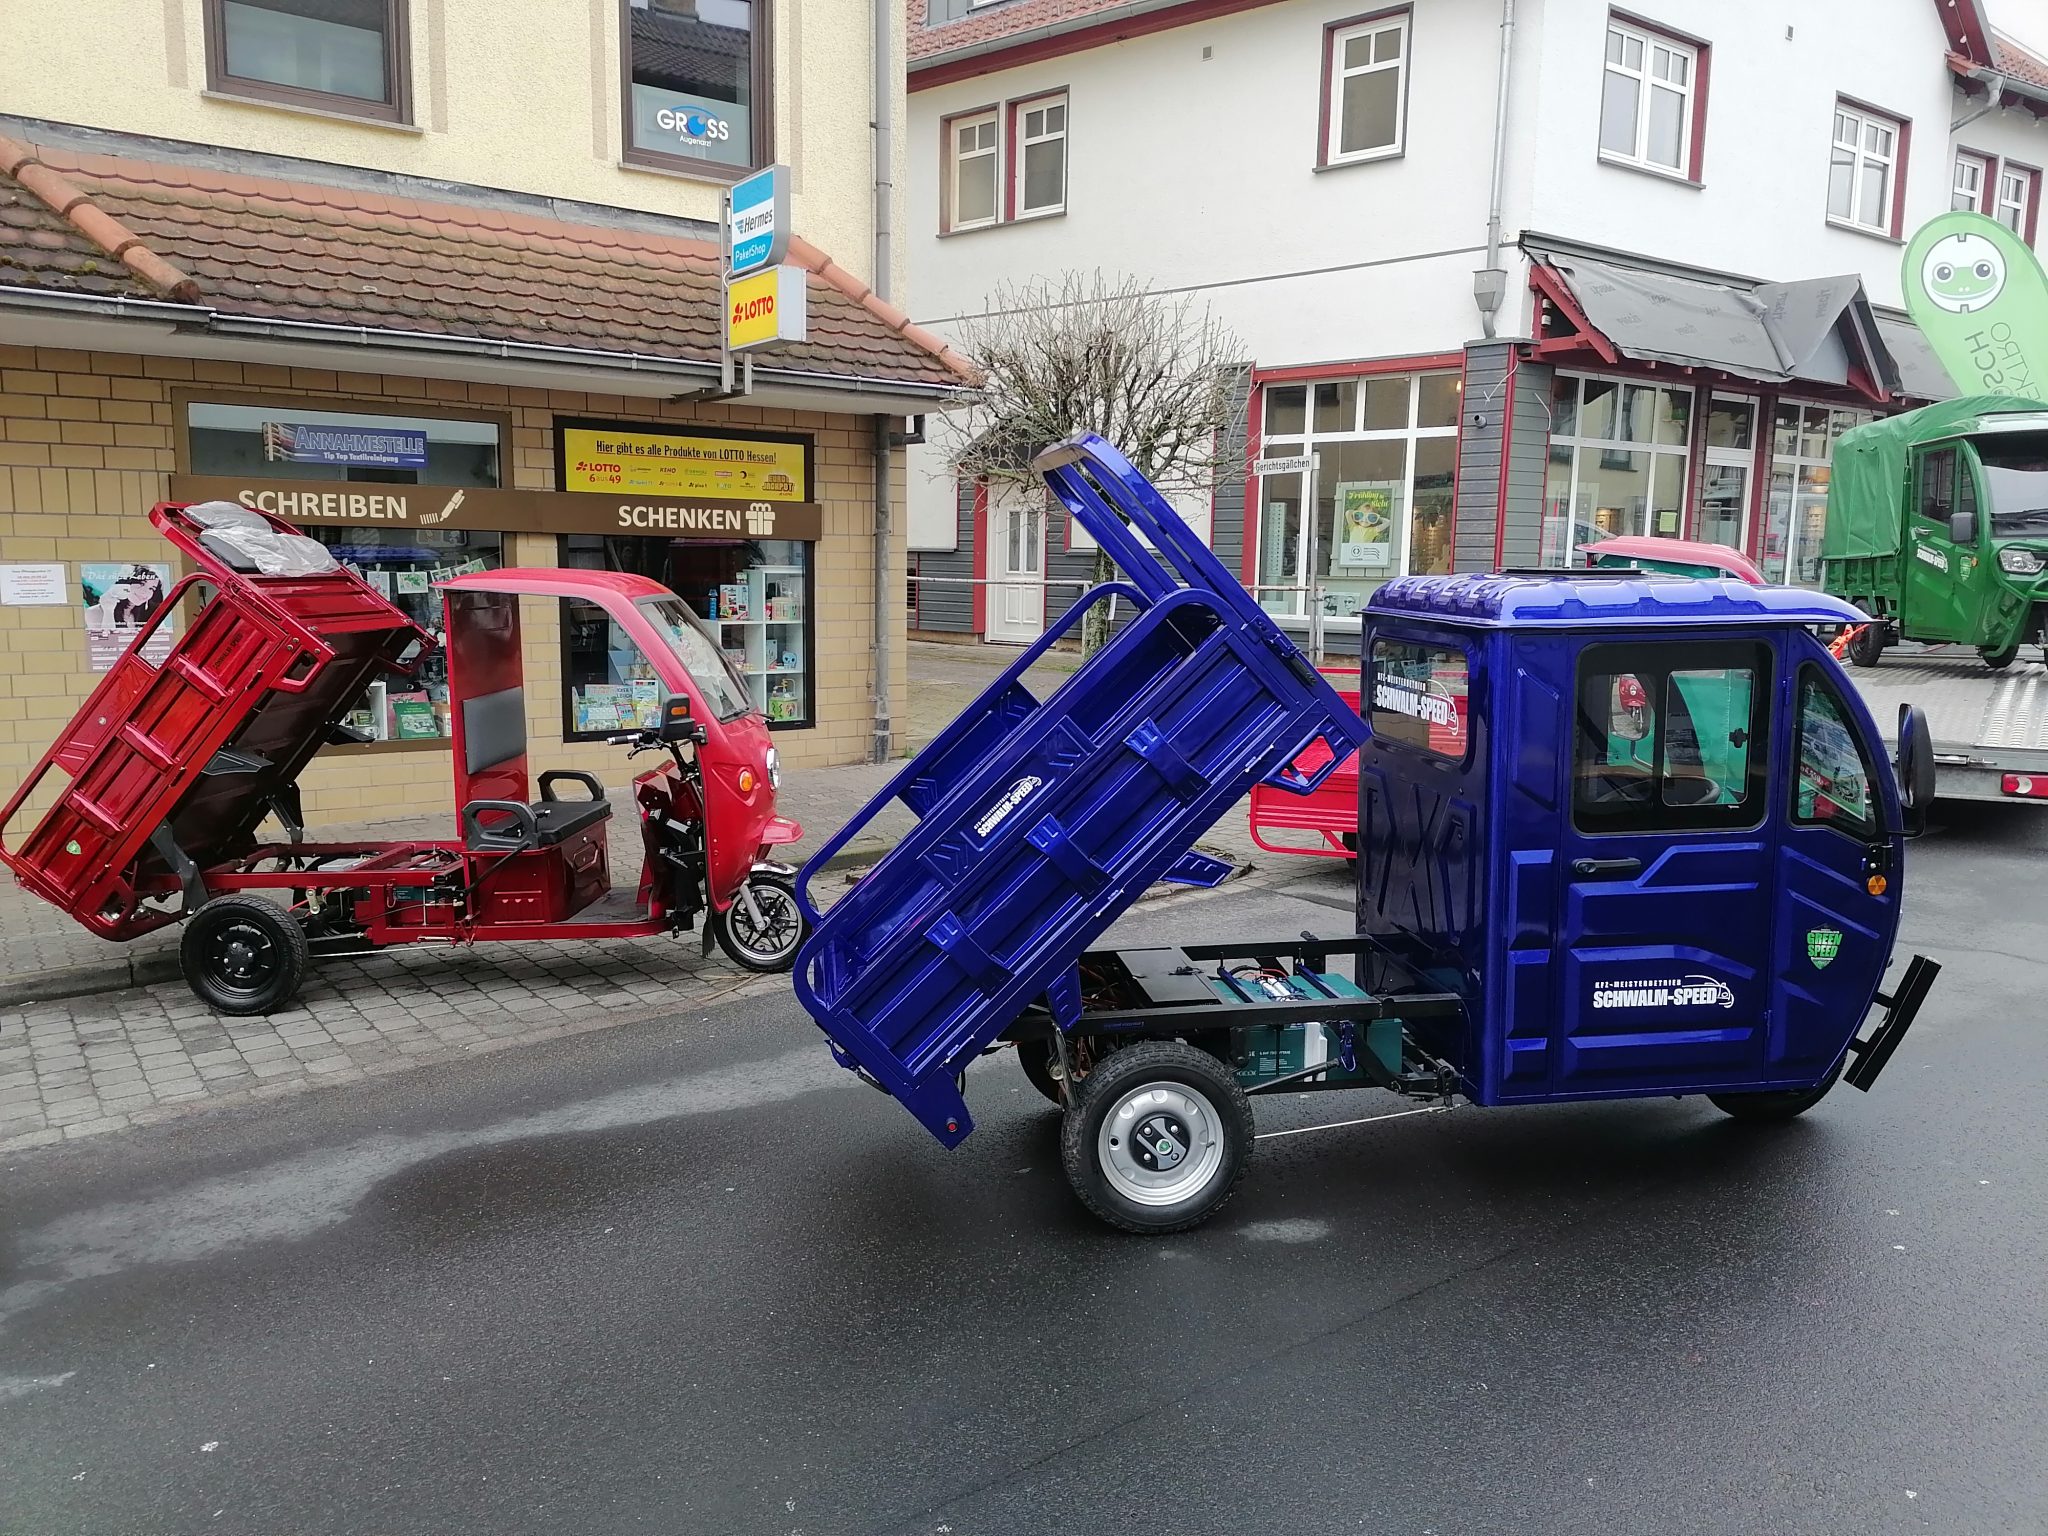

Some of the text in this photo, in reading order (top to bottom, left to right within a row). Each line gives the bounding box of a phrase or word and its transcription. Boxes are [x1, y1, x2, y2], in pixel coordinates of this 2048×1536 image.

[656, 109, 729, 141] GROSS
[680, 135, 712, 147] Augenarzt
[744, 209, 773, 234] Hermes
[735, 243, 766, 262] PaketShop
[745, 295, 774, 320] LOTTO
[294, 426, 425, 455] ANNAHMESTELLE
[596, 440, 777, 463] Hier gibt es alle Produkte von LOTTO Hessen!
[324, 452, 399, 463] Tip Top Textilreinigung
[589, 463, 621, 473] LOTTO
[589, 474, 596, 483] 6
[609, 474, 621, 484] 49
[238, 489, 407, 519] SCHREIBEN
[618, 505, 741, 530] SCHENKEN
[1376, 684, 1448, 726] SCHWALM-SPEED
[977, 781, 1034, 838] SCHWALM-SPEED
[1807, 932, 1843, 945] GREEN
[1808, 945, 1838, 957] SPEED
[1593, 987, 1718, 1008] SCHWALM-SPEED
